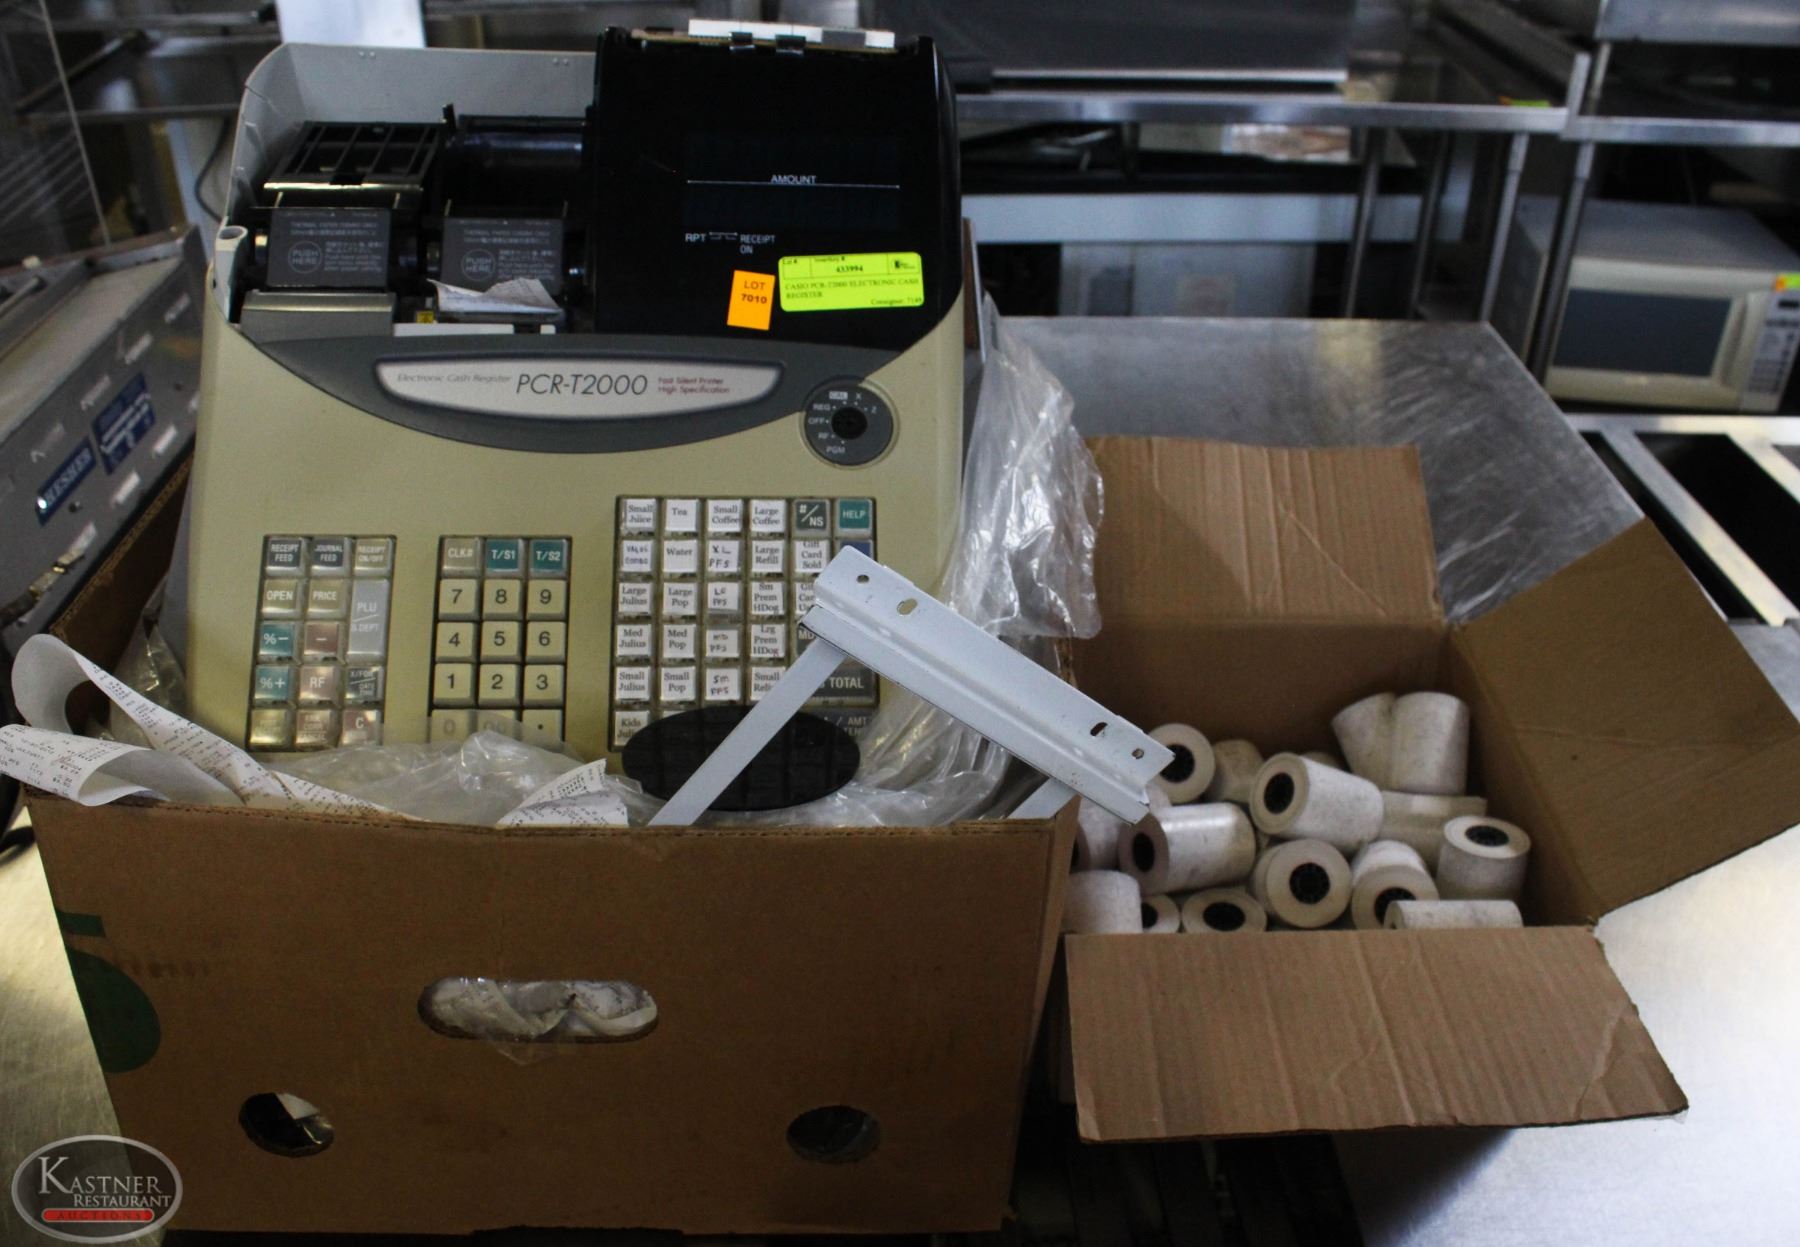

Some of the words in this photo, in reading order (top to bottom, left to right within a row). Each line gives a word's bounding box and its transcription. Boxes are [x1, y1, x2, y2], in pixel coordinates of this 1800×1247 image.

[771, 175, 816, 184] AMOUNT
[685, 233, 706, 242] RPT
[740, 234, 775, 243] RECEIPT
[740, 245, 753, 254] ON
[744, 280, 766, 290] LOT
[741, 293, 768, 304] 7010
[397, 373, 443, 382] Electronic
[446, 373, 471, 382] Cash
[473, 374, 512, 384] Register
[515, 373, 648, 396] PCR-T2000
[658, 386, 676, 395] High
[680, 386, 730, 395] Specification
[628, 504, 653, 513] Small
[672, 507, 688, 516] Tea
[713, 505, 738, 513] Small
[754, 507, 779, 516] Large
[842, 510, 866, 519] HELP
[712, 516, 740, 524] Coffee
[752, 517, 780, 525] Coffee
[270, 544, 299, 552] RECEIPT
[314, 544, 343, 552] JOURNAL
[666, 547, 693, 556] Water
[755, 546, 780, 555] Large
[274, 553, 294, 562] FEED
[320, 554, 337, 562] FEED
[491, 549, 516, 560] T/S1
[536, 551, 561, 561] T/S2
[801, 550, 822, 559] Card
[755, 556, 779, 564] Refill
[802, 560, 822, 569] Sold
[622, 585, 647, 595] Large
[759, 582, 773, 591] Sm
[266, 590, 294, 601] OPEN
[313, 591, 337, 601] PRICE
[452, 589, 463, 604] 7
[495, 589, 507, 604] 8
[540, 589, 552, 604] 9
[668, 587, 693, 597] Large
[620, 596, 648, 605] Julius
[754, 593, 777, 601] Prem
[798, 593, 815, 601] Car
[356, 602, 377, 612] PLU
[671, 598, 689, 608] Pop
[753, 603, 779, 613] HDog
[623, 628, 643, 637] Med
[667, 629, 688, 637] Med
[760, 625, 776, 634] Lrg
[449, 632, 461, 647] 4
[494, 631, 506, 646] 5
[539, 631, 551, 646] 6
[754, 635, 777, 644] Prem
[619, 639, 646, 648] Julius
[668, 640, 687, 650] Pop
[753, 646, 779, 657] HDog
[619, 671, 645, 680] Small
[664, 672, 689, 681] Small
[754, 672, 780, 681] Small
[309, 676, 326, 689] RF
[447, 674, 455, 689] 1
[491, 674, 504, 689] 2
[536, 674, 549, 690] 3
[830, 677, 864, 689] TOTAL
[618, 682, 646, 691] Julius
[668, 683, 686, 694] Pop
[355, 717, 364, 729] C
[621, 718, 641, 727] Kids
[617, 728, 635, 738] Juli
